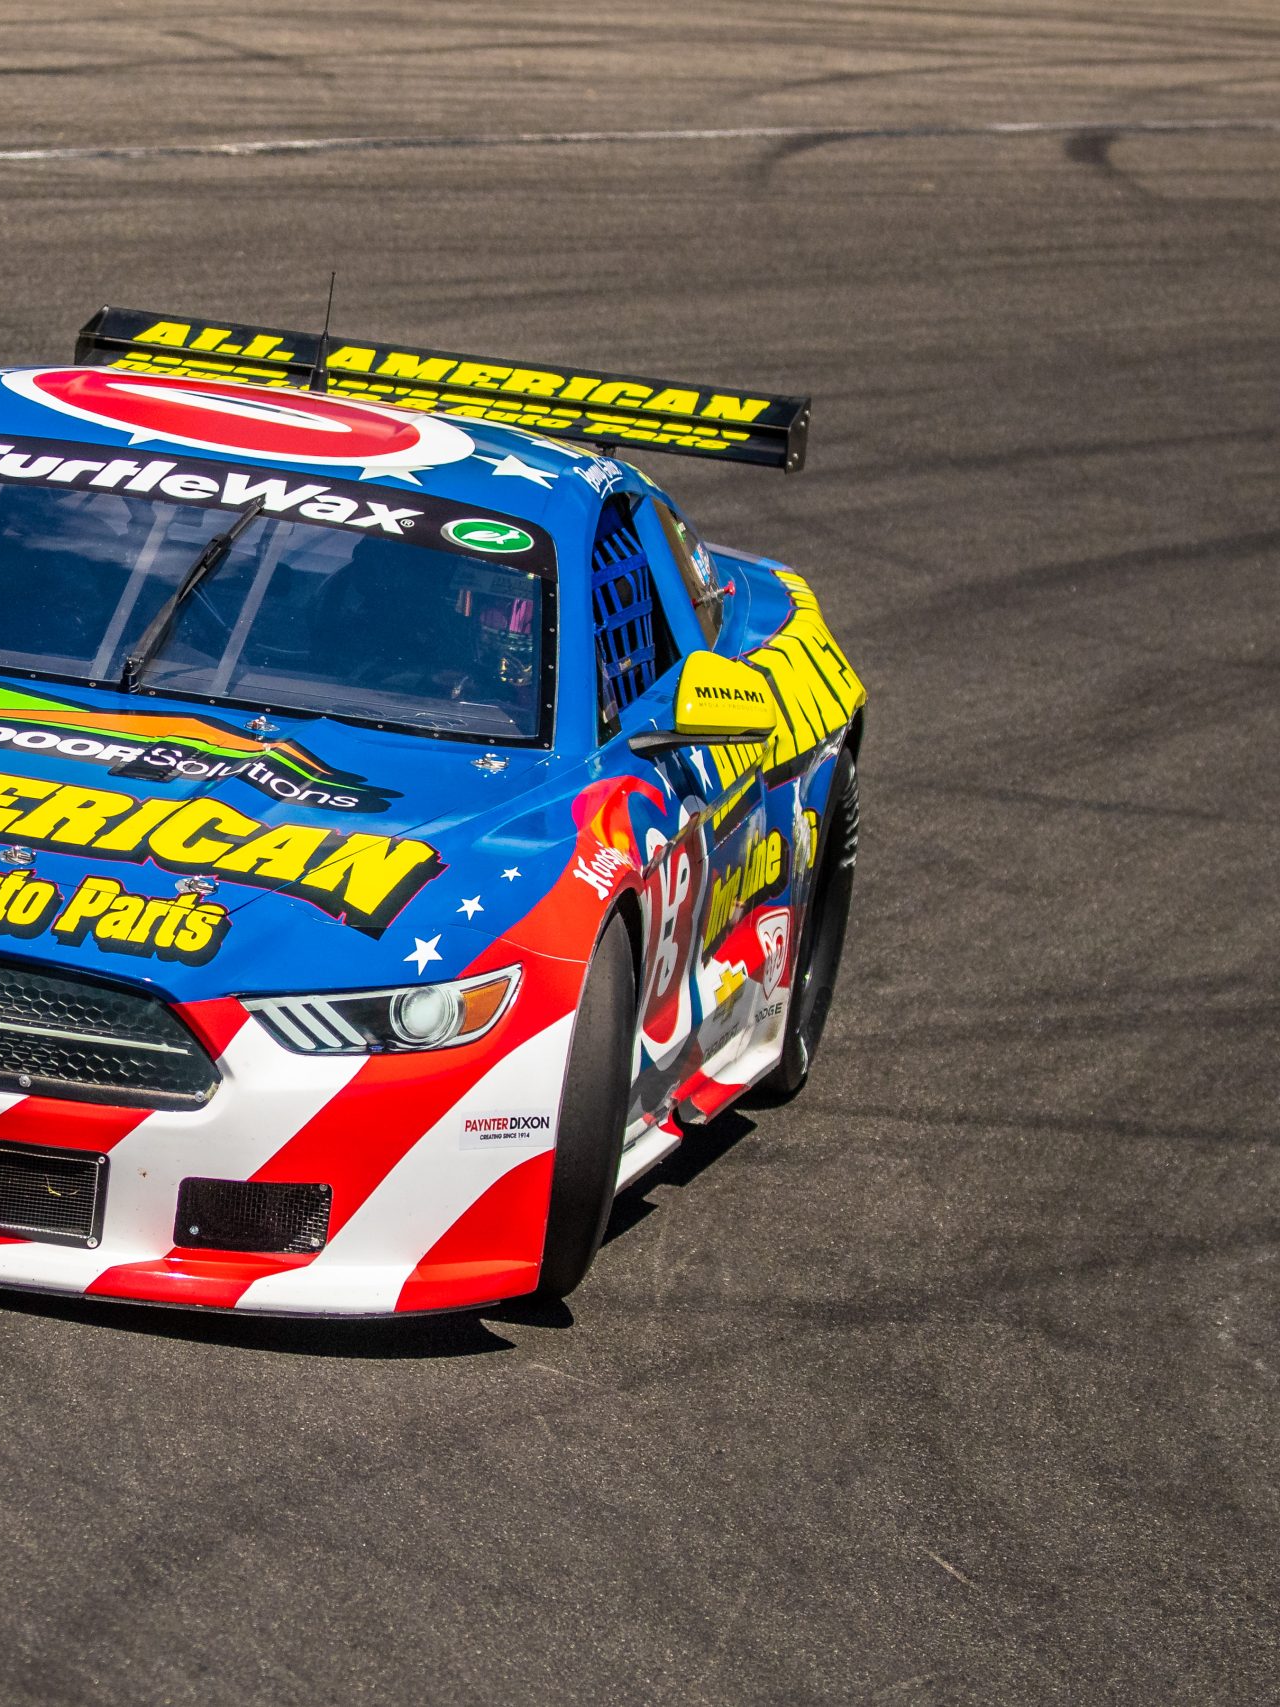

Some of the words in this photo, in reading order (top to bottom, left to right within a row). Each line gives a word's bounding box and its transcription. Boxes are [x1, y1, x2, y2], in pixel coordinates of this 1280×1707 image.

[125, 321, 295, 379] ALL
[326, 346, 770, 441] AMERICAN
[444, 404, 573, 429] Auto
[583, 422, 732, 450] Parts
[694, 686, 765, 704] MINAMI
[143, 747, 360, 809] Solutions
[54, 877, 225, 953] Parts
